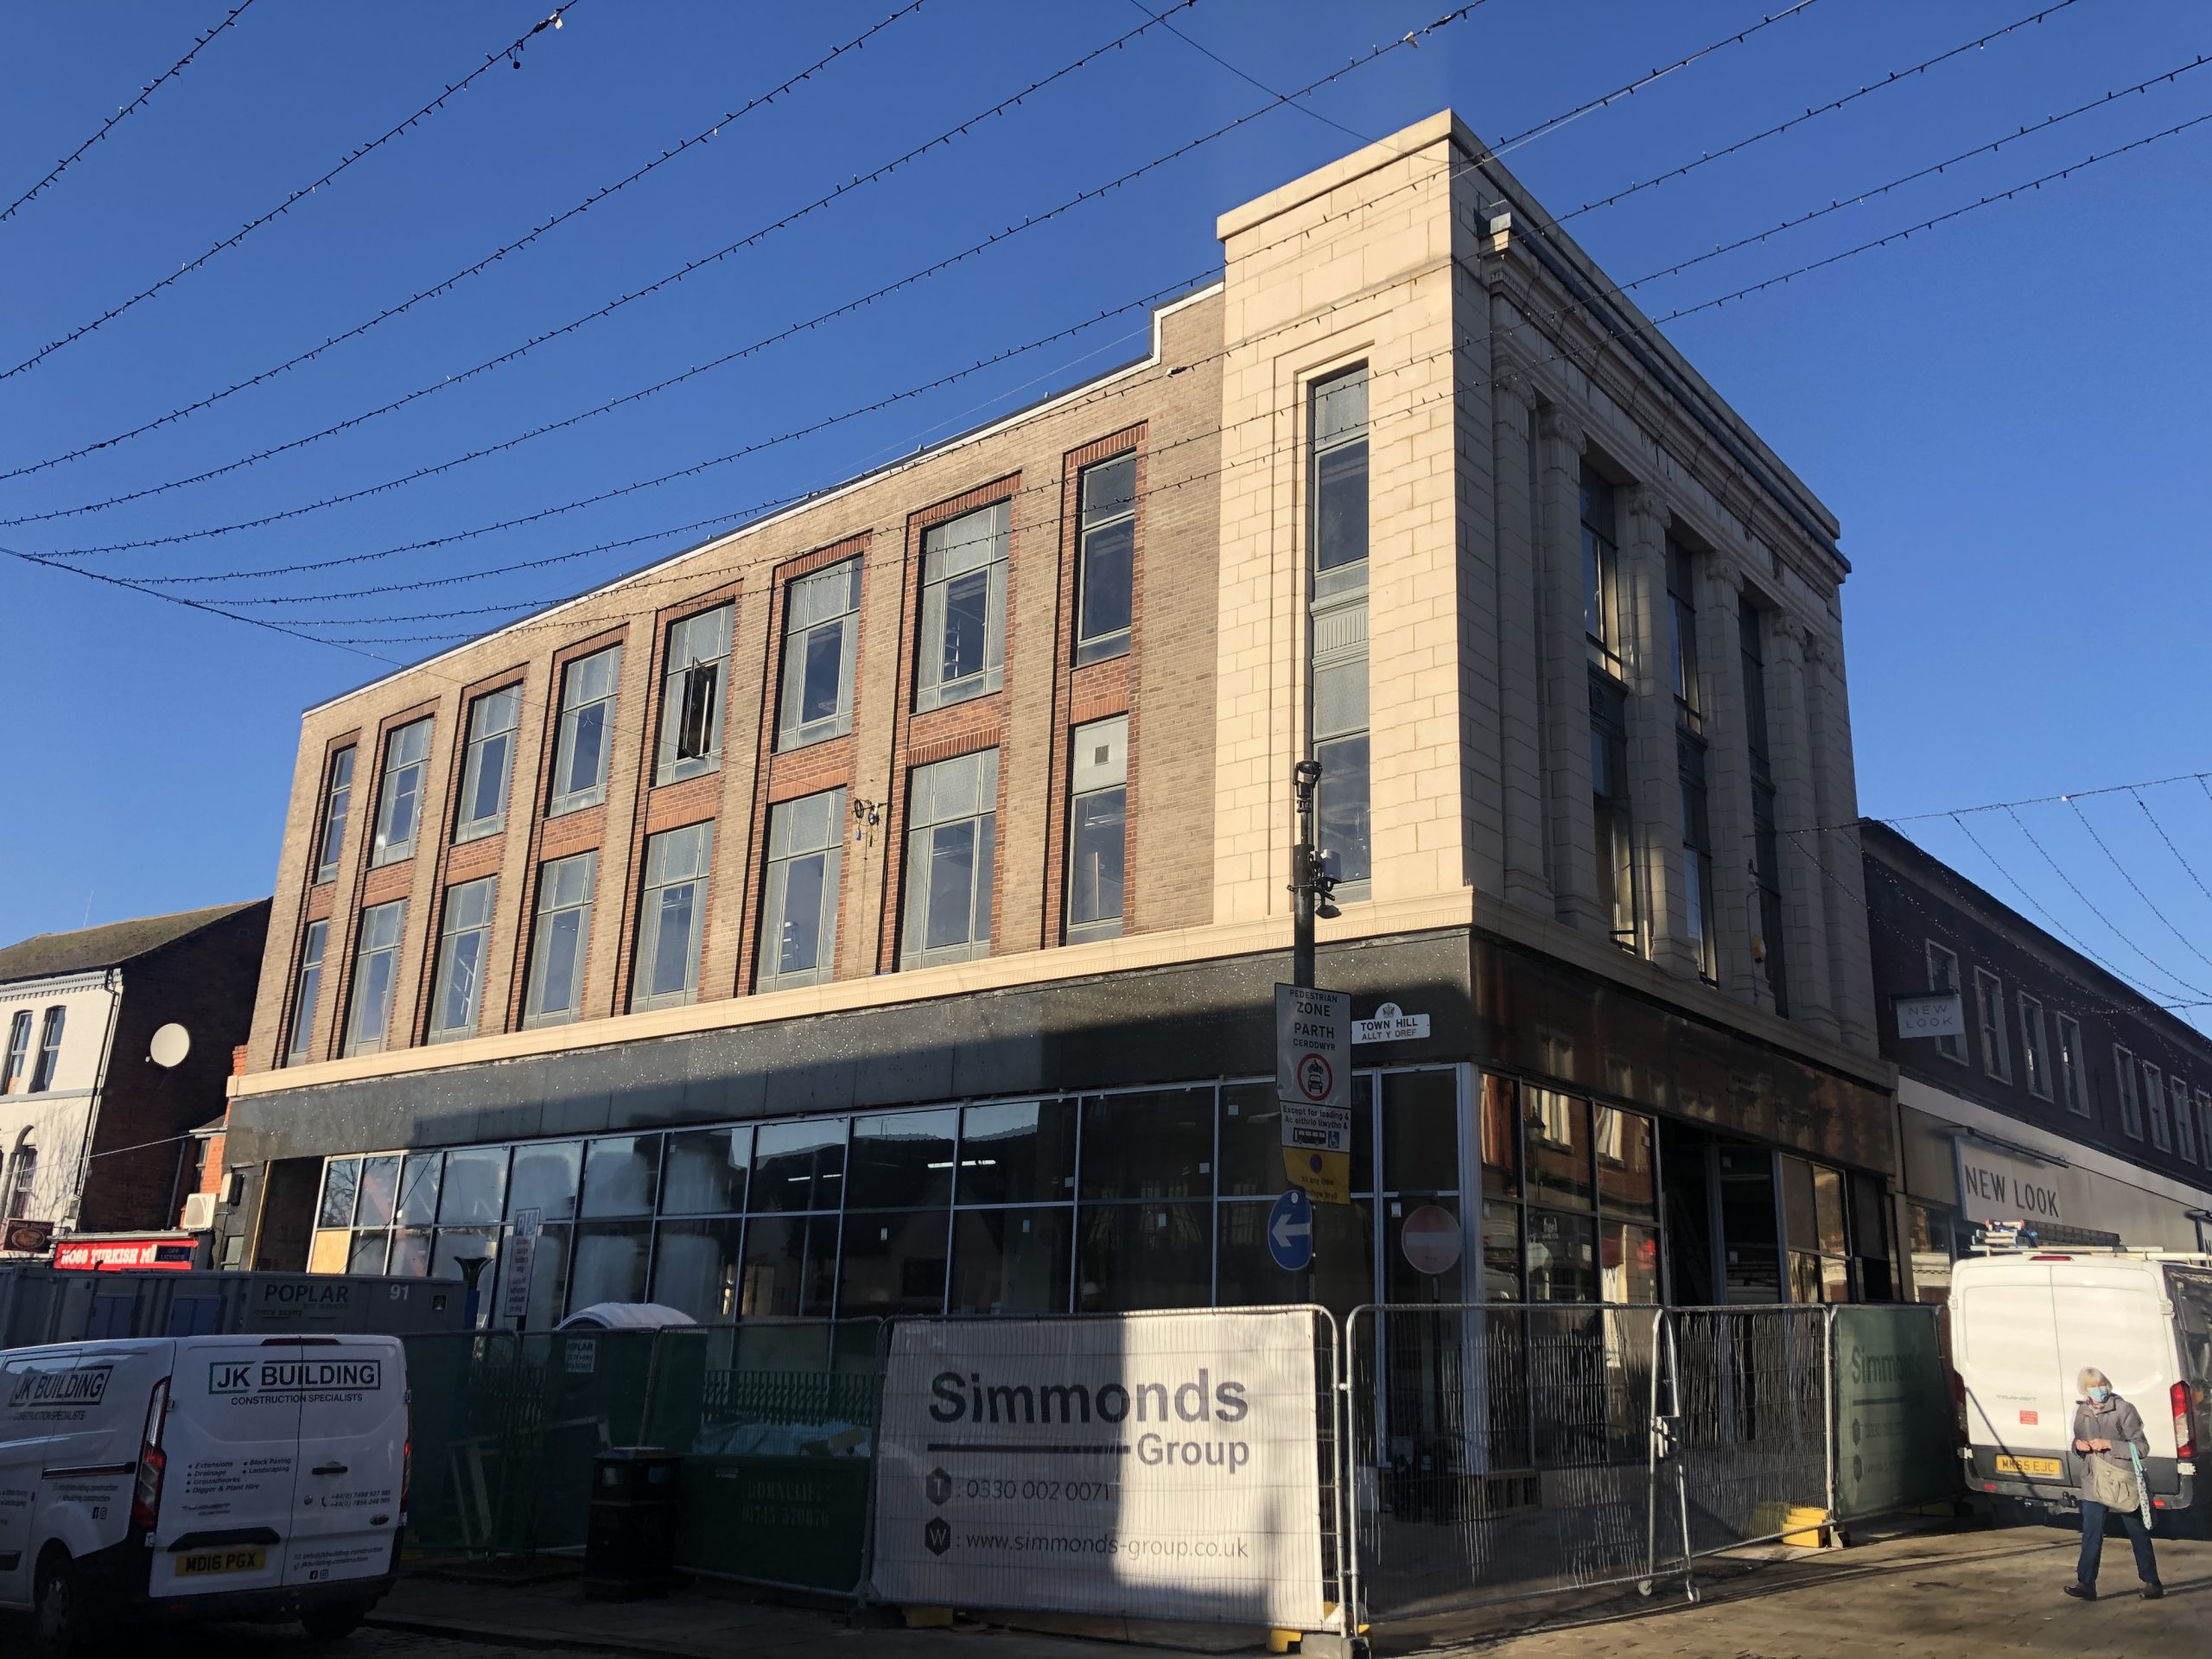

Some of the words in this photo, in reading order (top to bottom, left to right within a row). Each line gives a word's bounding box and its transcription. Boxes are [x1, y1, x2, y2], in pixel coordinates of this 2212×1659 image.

[1289, 988, 1338, 1003] PEDESTRIAN
[1296, 1001, 1331, 1017] ZONE
[1908, 1004, 1948, 1016] NEW
[1294, 1022, 1334, 1039] PARTH
[1360, 1020, 1390, 1032] TOWN
[1395, 1017, 1418, 1027] HILL
[1906, 1016, 1953, 1029] LOOK
[1362, 1032, 1382, 1041] ALLT
[1385, 1030, 1392, 1039] Y
[1395, 1028, 1417, 1038] DREF
[1294, 1039, 1336, 1052] CERDDWYR
[1283, 1105, 1306, 1116] Except
[1308, 1107, 1318, 1116] for
[1319, 1109, 1343, 1121] loading
[1965, 1164, 2005, 1204] NEW
[2013, 1179, 2060, 1218] LOOK
[91, 1248, 139, 1265] TURKISH
[264, 1283, 349, 1303] POPLAR
[390, 1283, 409, 1301] 91
[217, 1366, 251, 1389] JK
[261, 1365, 375, 1387] BUILDING
[15, 1375, 36, 1400] JK
[34, 1372, 105, 1399] BUILDING
[231, 1395, 306, 1406] CONSTRUCTION
[308, 1393, 363, 1403] SPECIALISTS
[929, 1369, 1249, 1424] Simmonds
[1137, 1433, 1249, 1474] Group
[2033, 1460, 2055, 1472] EJC
[193, 1477, 240, 1485] Groundworks
[966, 1480, 1016, 1500] 0330
[1022, 1481, 1059, 1501] 002
[1065, 1482, 1110, 1502] 0071
[966, 1533, 1249, 1560] www.simmonds-group.co.uk
[226, 1552, 256, 1570] PGX
